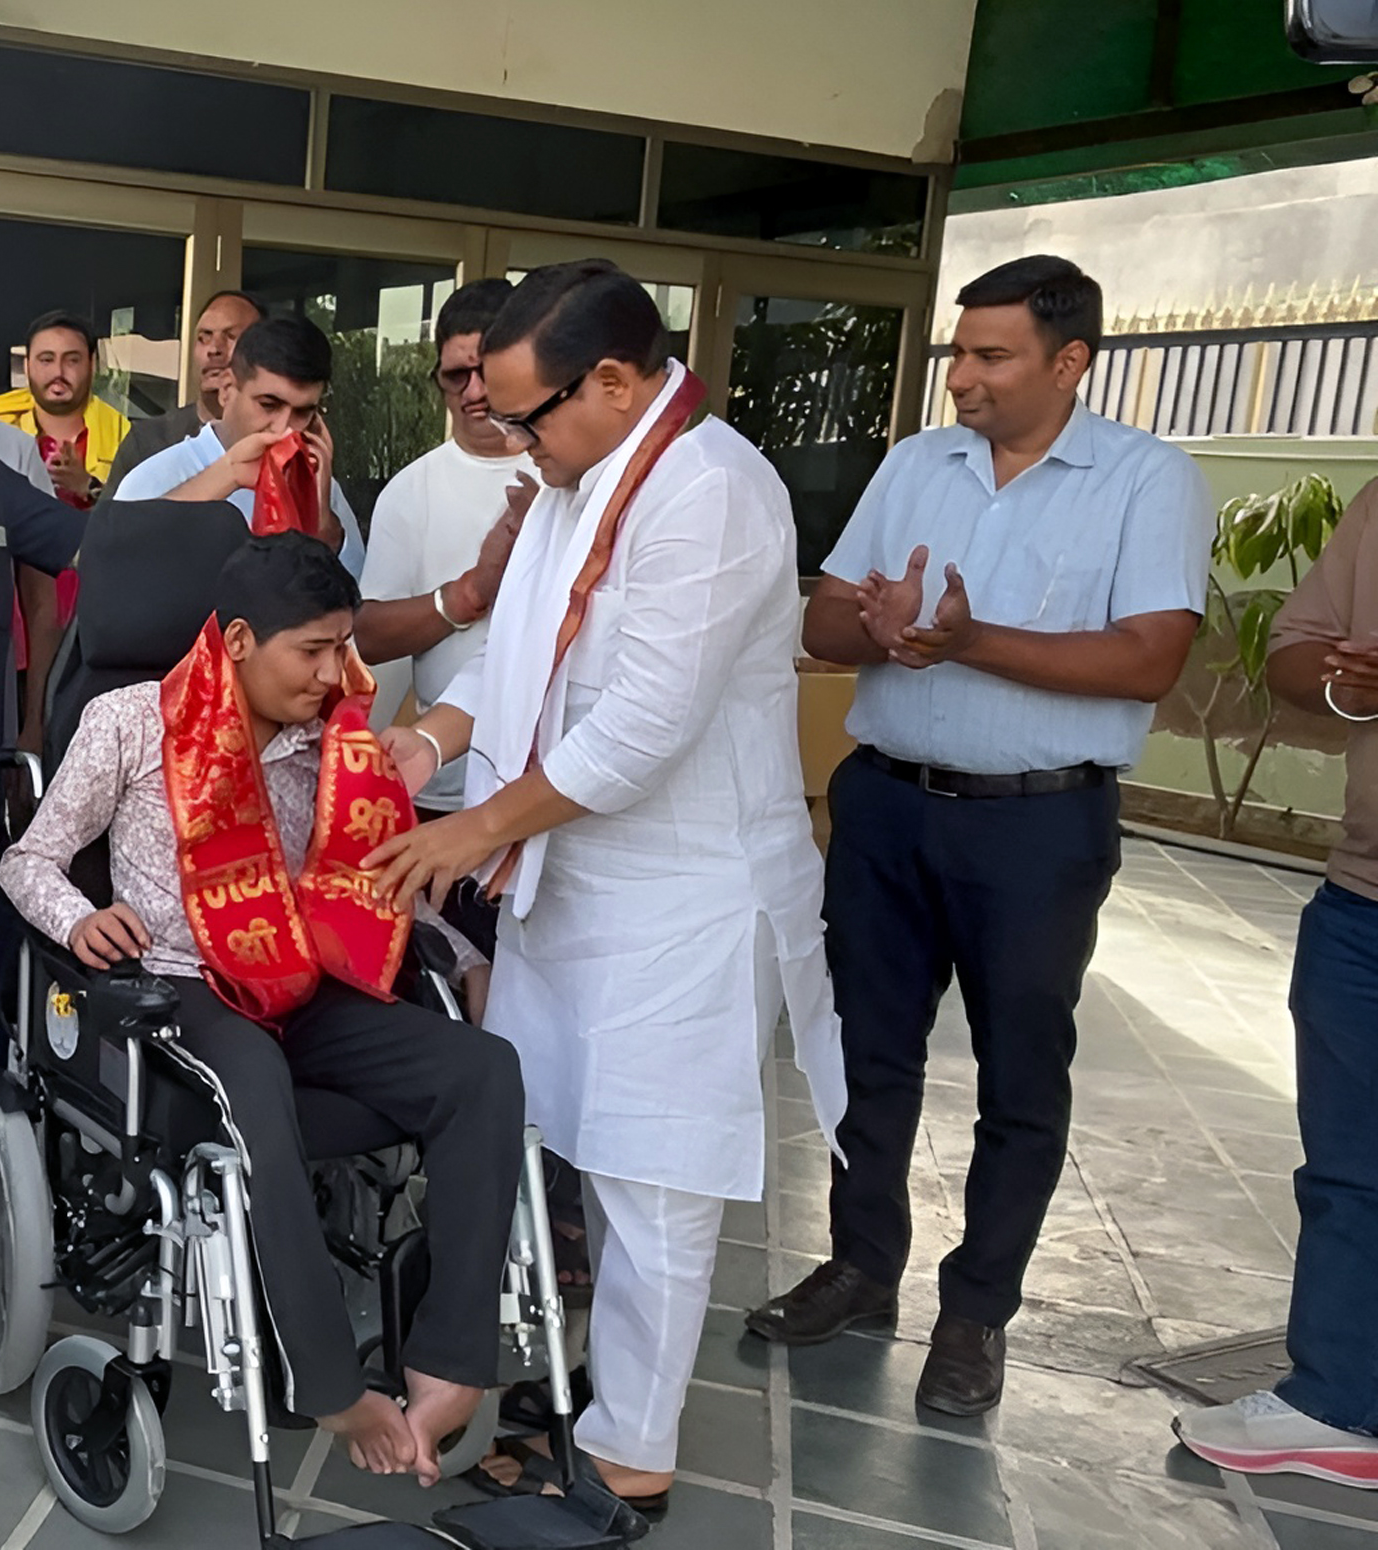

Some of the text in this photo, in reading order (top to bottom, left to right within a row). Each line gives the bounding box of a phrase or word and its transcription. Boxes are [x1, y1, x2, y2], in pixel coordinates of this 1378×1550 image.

[343, 797, 401, 848] श्री
[199, 852, 275, 909] जय
[227, 917, 282, 966] श्री
